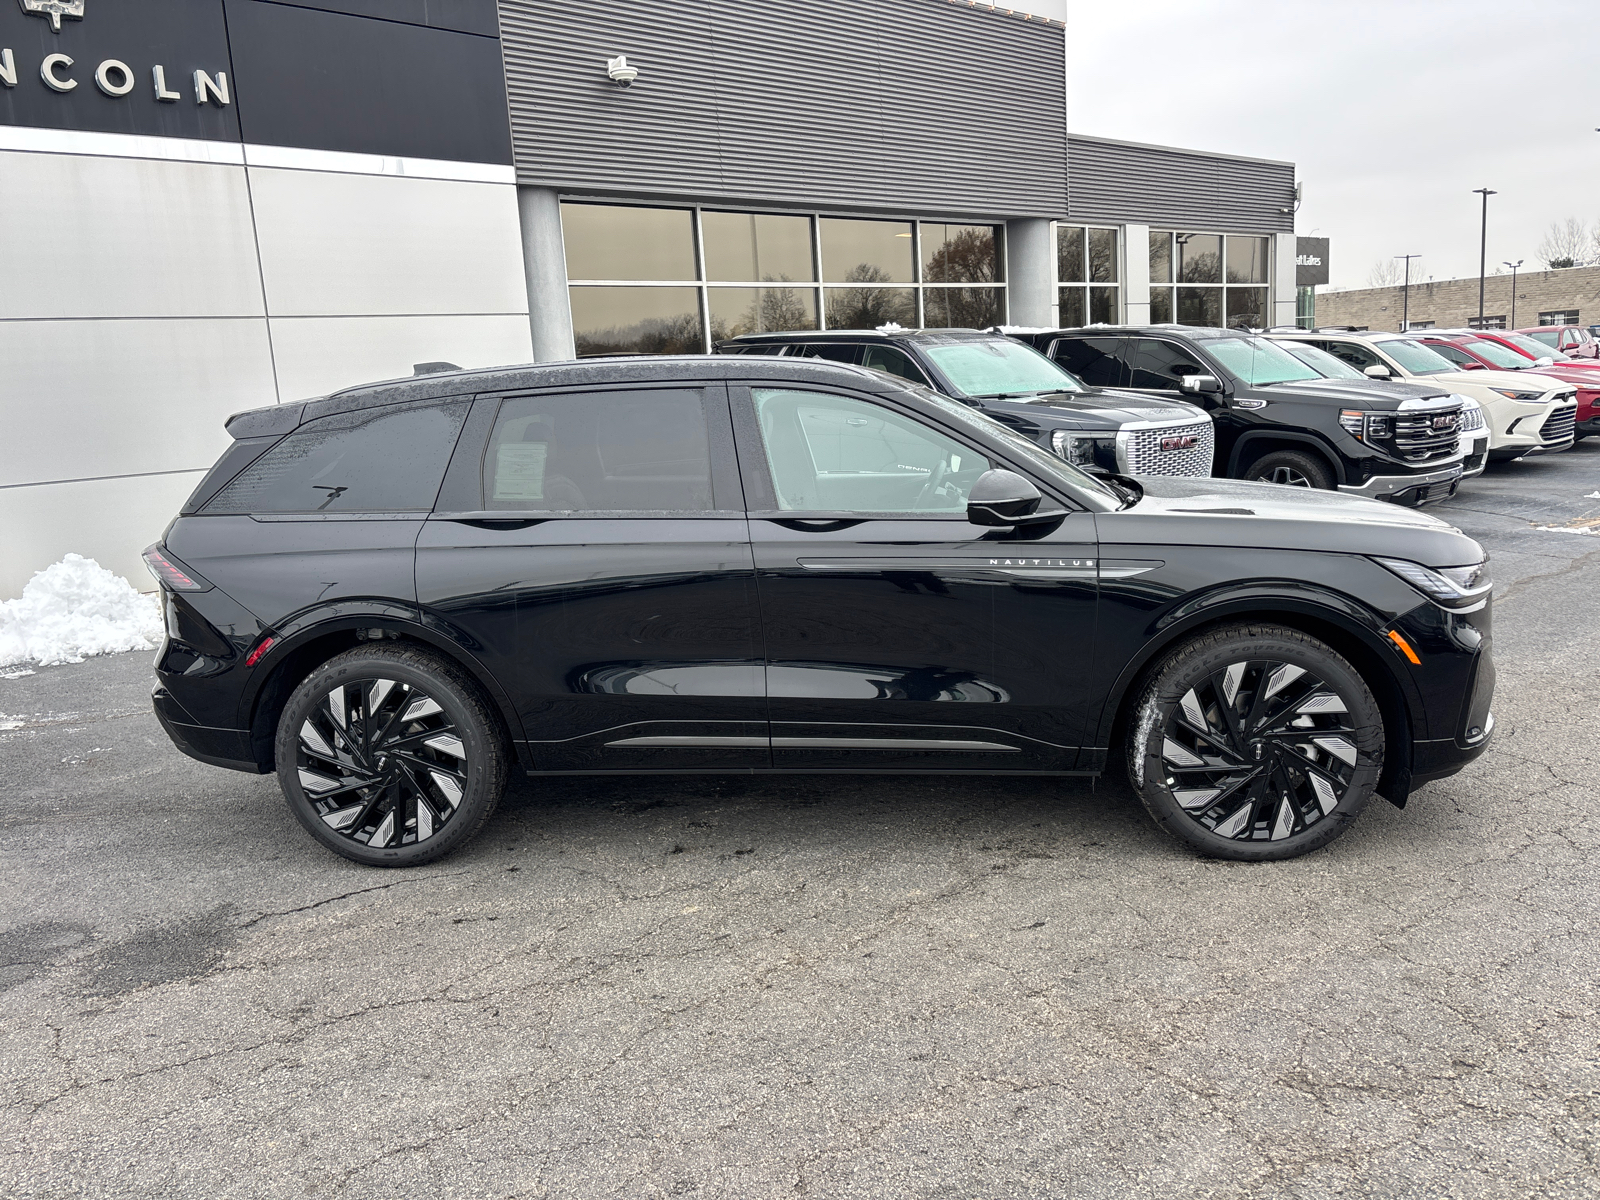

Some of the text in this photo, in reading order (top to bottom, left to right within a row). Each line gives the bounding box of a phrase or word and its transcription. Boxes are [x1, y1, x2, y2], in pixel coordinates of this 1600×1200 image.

[1433, 414, 1456, 428] GMC
[1162, 435, 1198, 450] GMC
[897, 464, 932, 473] DENAL
[1229, 644, 1307, 657] TOURING
